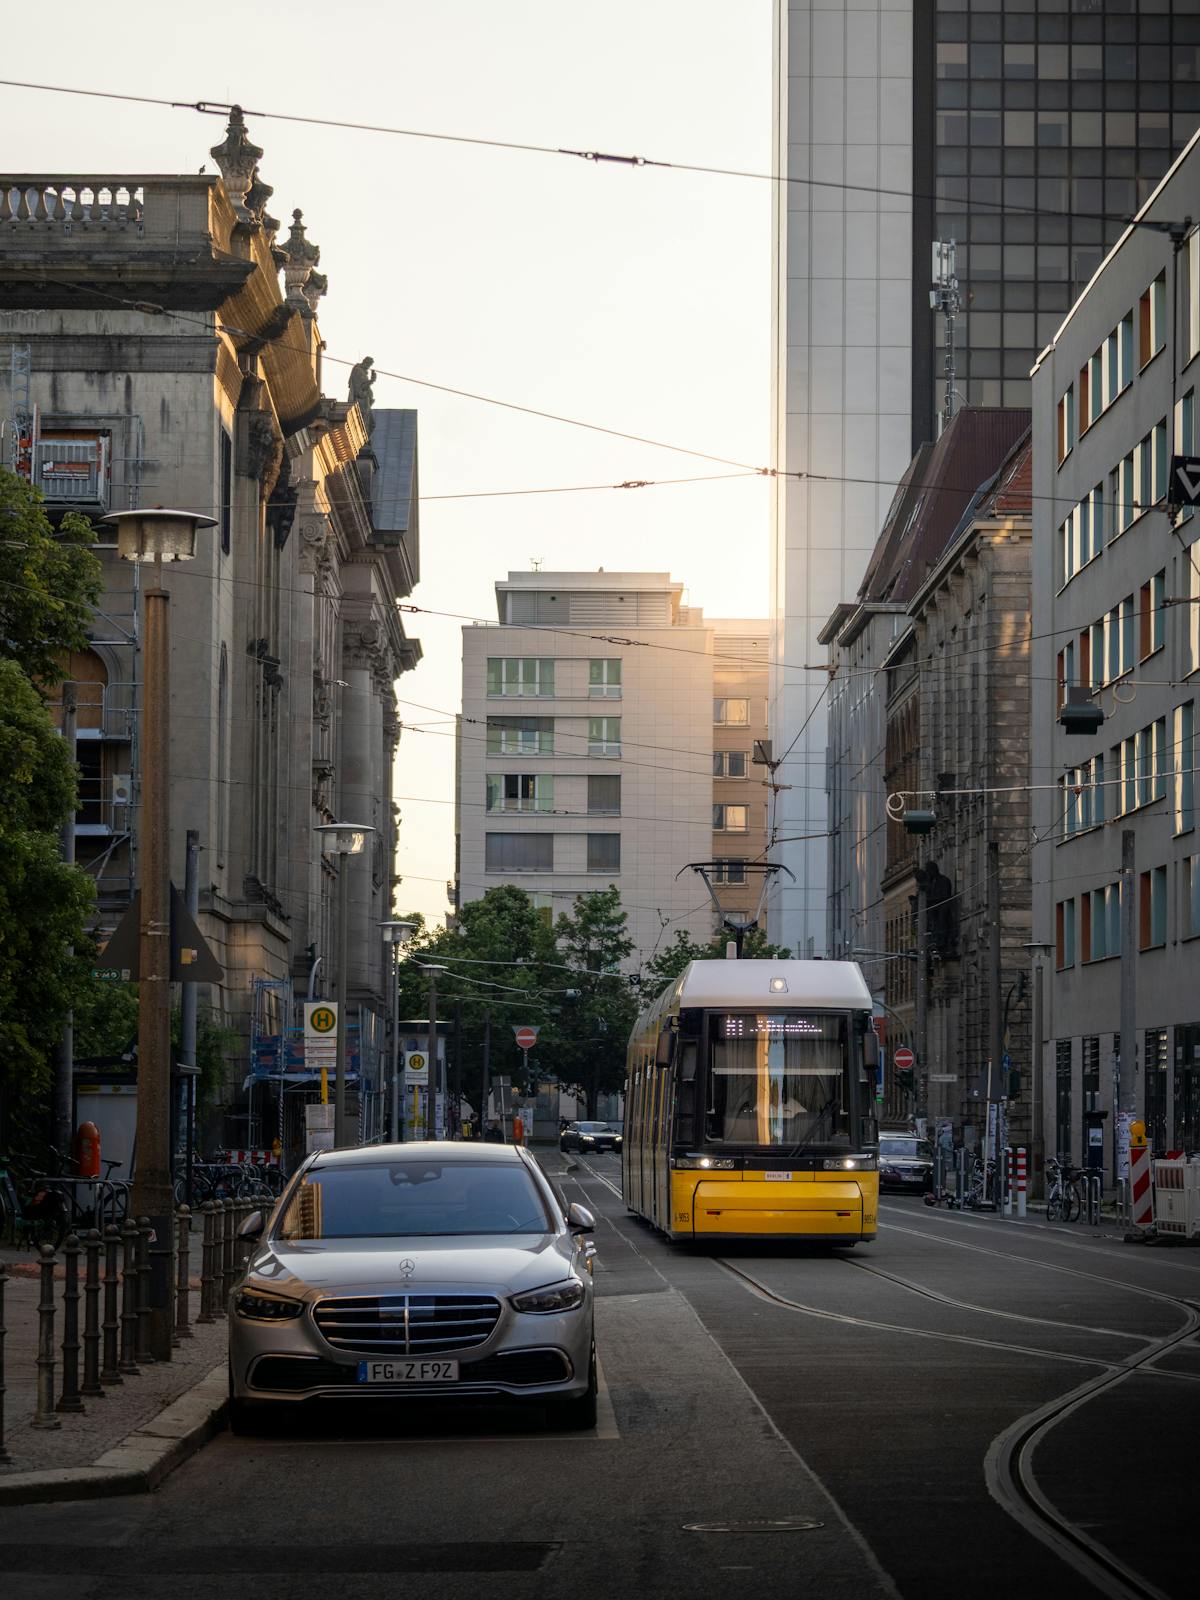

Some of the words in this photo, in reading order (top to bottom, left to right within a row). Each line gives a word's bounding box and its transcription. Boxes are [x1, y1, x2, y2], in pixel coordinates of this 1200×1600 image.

[316, 1013, 329, 1027] H
[413, 1058, 421, 1066] H
[373, 1364, 394, 1379] FG
